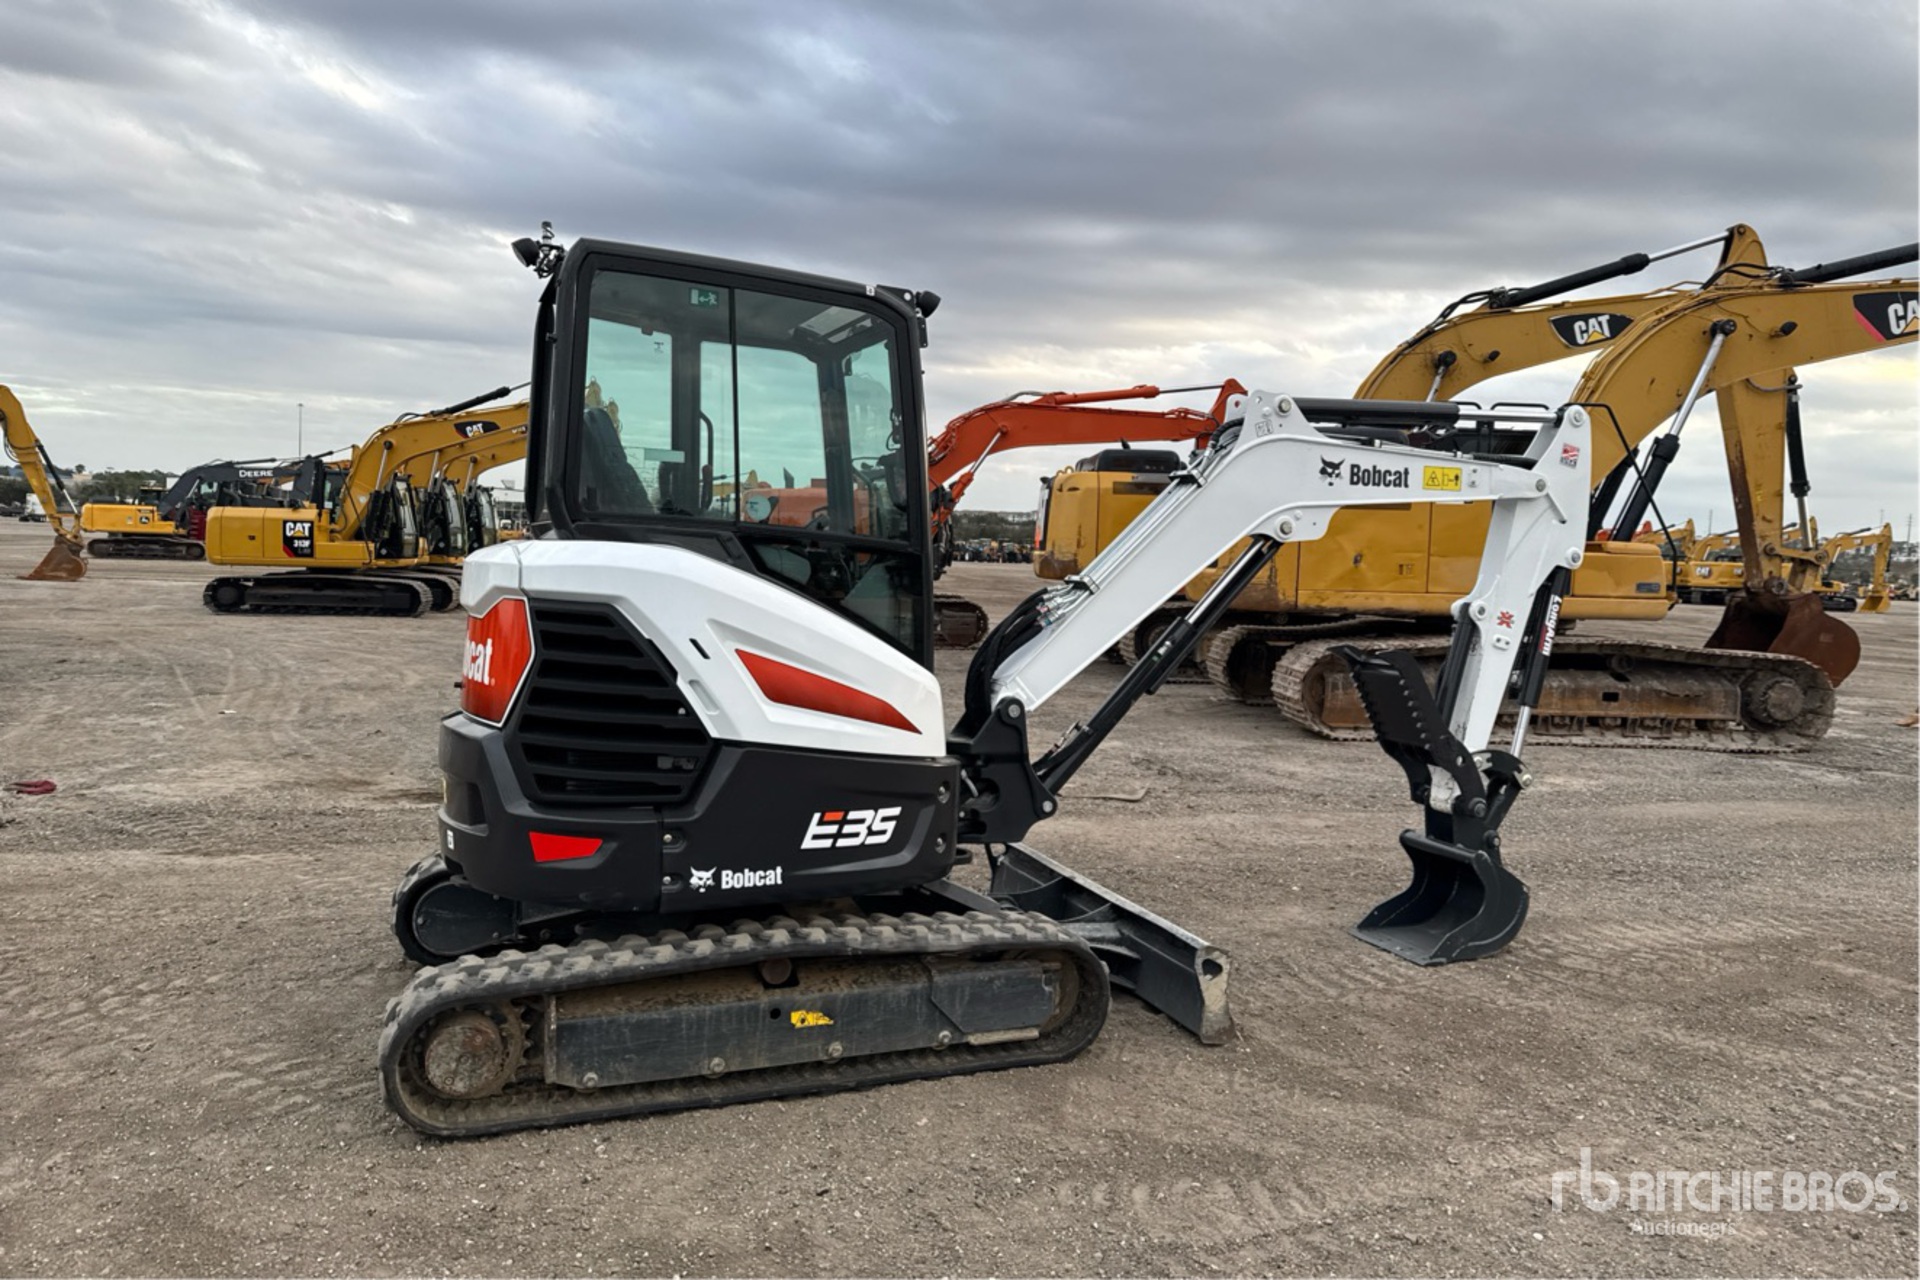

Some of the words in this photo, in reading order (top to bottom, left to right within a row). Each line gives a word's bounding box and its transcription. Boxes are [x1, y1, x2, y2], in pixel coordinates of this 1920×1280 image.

[1573, 314, 1611, 345] CAT
[465, 423, 484, 438] CAT
[239, 469, 274, 478] DEERE
[1349, 464, 1410, 488] Bobcat
[285, 521, 311, 537] CAT
[800, 806, 902, 850] E35
[720, 866, 783, 890] Bobcat
